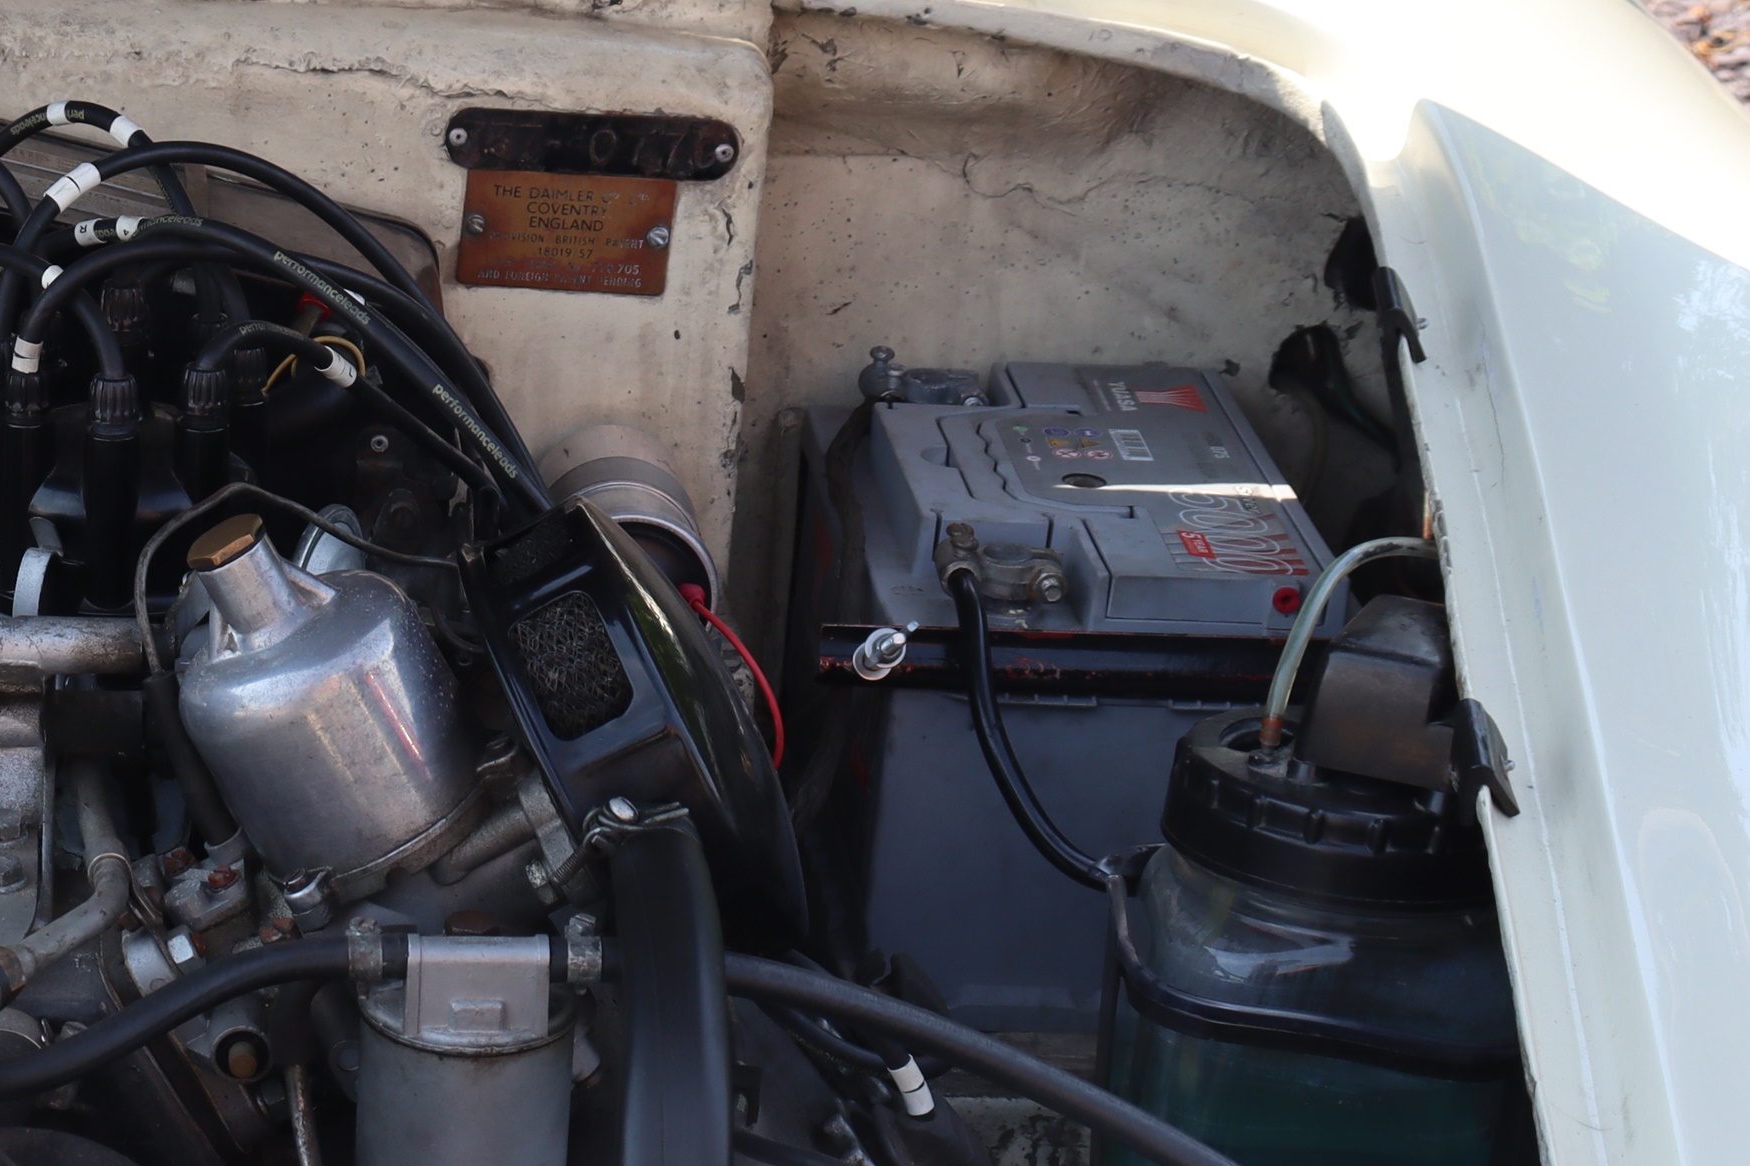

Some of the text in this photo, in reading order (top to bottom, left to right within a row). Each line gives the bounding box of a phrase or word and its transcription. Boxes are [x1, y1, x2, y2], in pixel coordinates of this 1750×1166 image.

[493, 183, 522, 198] THE
[529, 186, 594, 202] DAIMLER
[526, 201, 608, 217] COVENTRY
[528, 216, 604, 232] ENGLAND
[555, 234, 596, 246] BRITISH
[273, 250, 372, 325] performanceleads
[1107, 381, 1139, 412] YUASA
[432, 383, 519, 479] performanceleads
